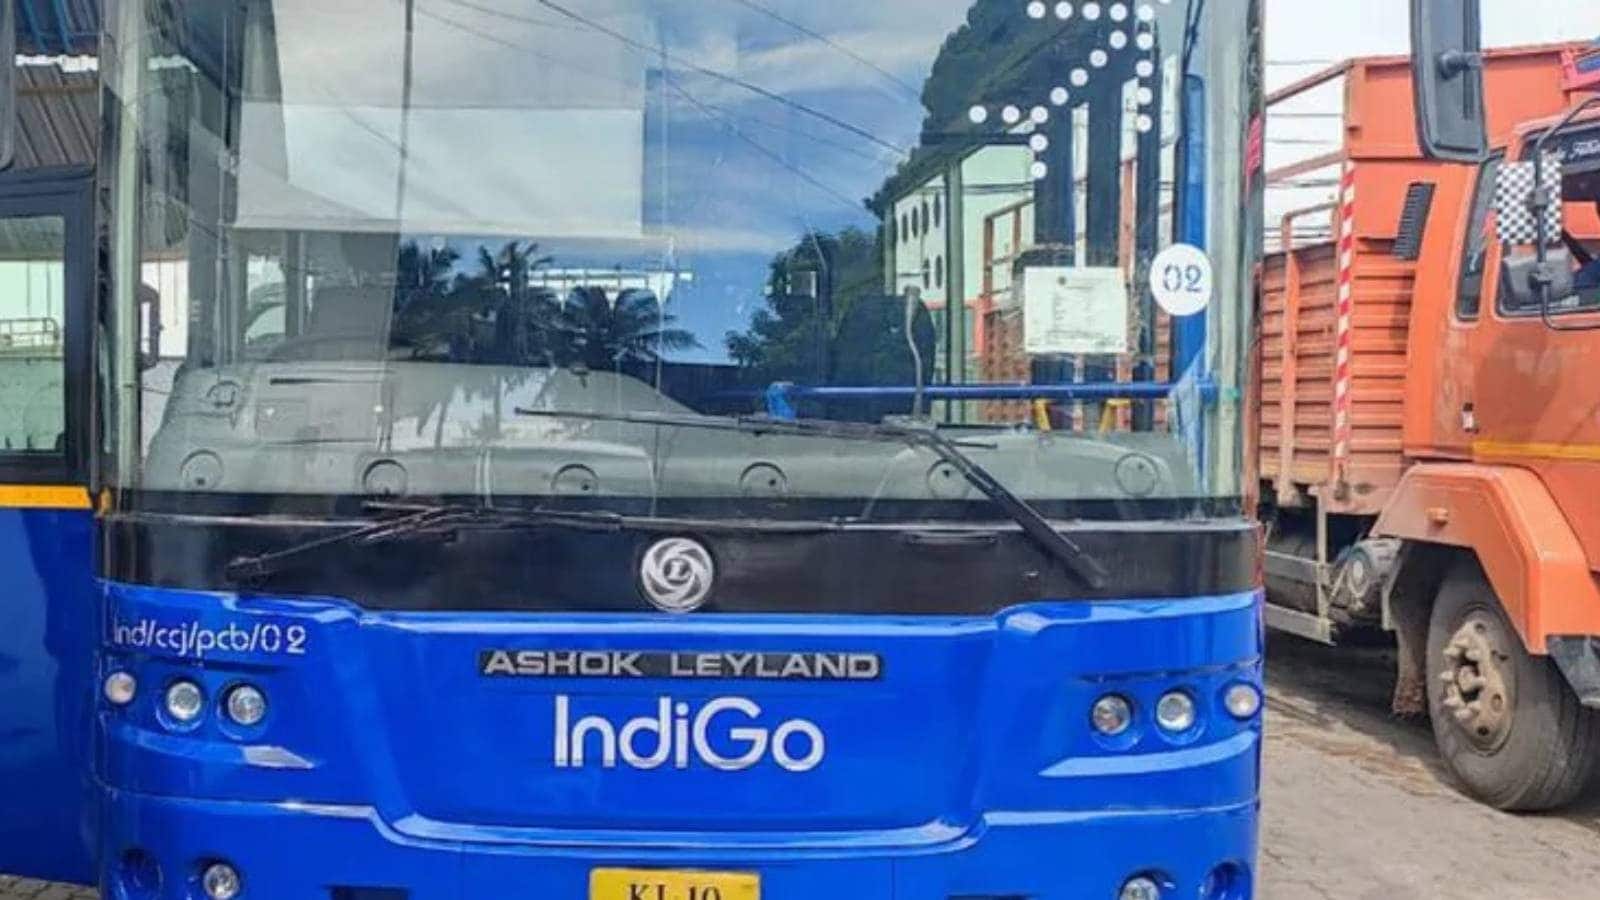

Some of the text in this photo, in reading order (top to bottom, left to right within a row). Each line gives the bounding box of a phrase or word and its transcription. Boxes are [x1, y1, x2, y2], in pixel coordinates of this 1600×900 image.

[1163, 263, 1202, 293] 02
[484, 650, 881, 679] ASHOK LEYLAND
[554, 694, 826, 772] IndiGo
